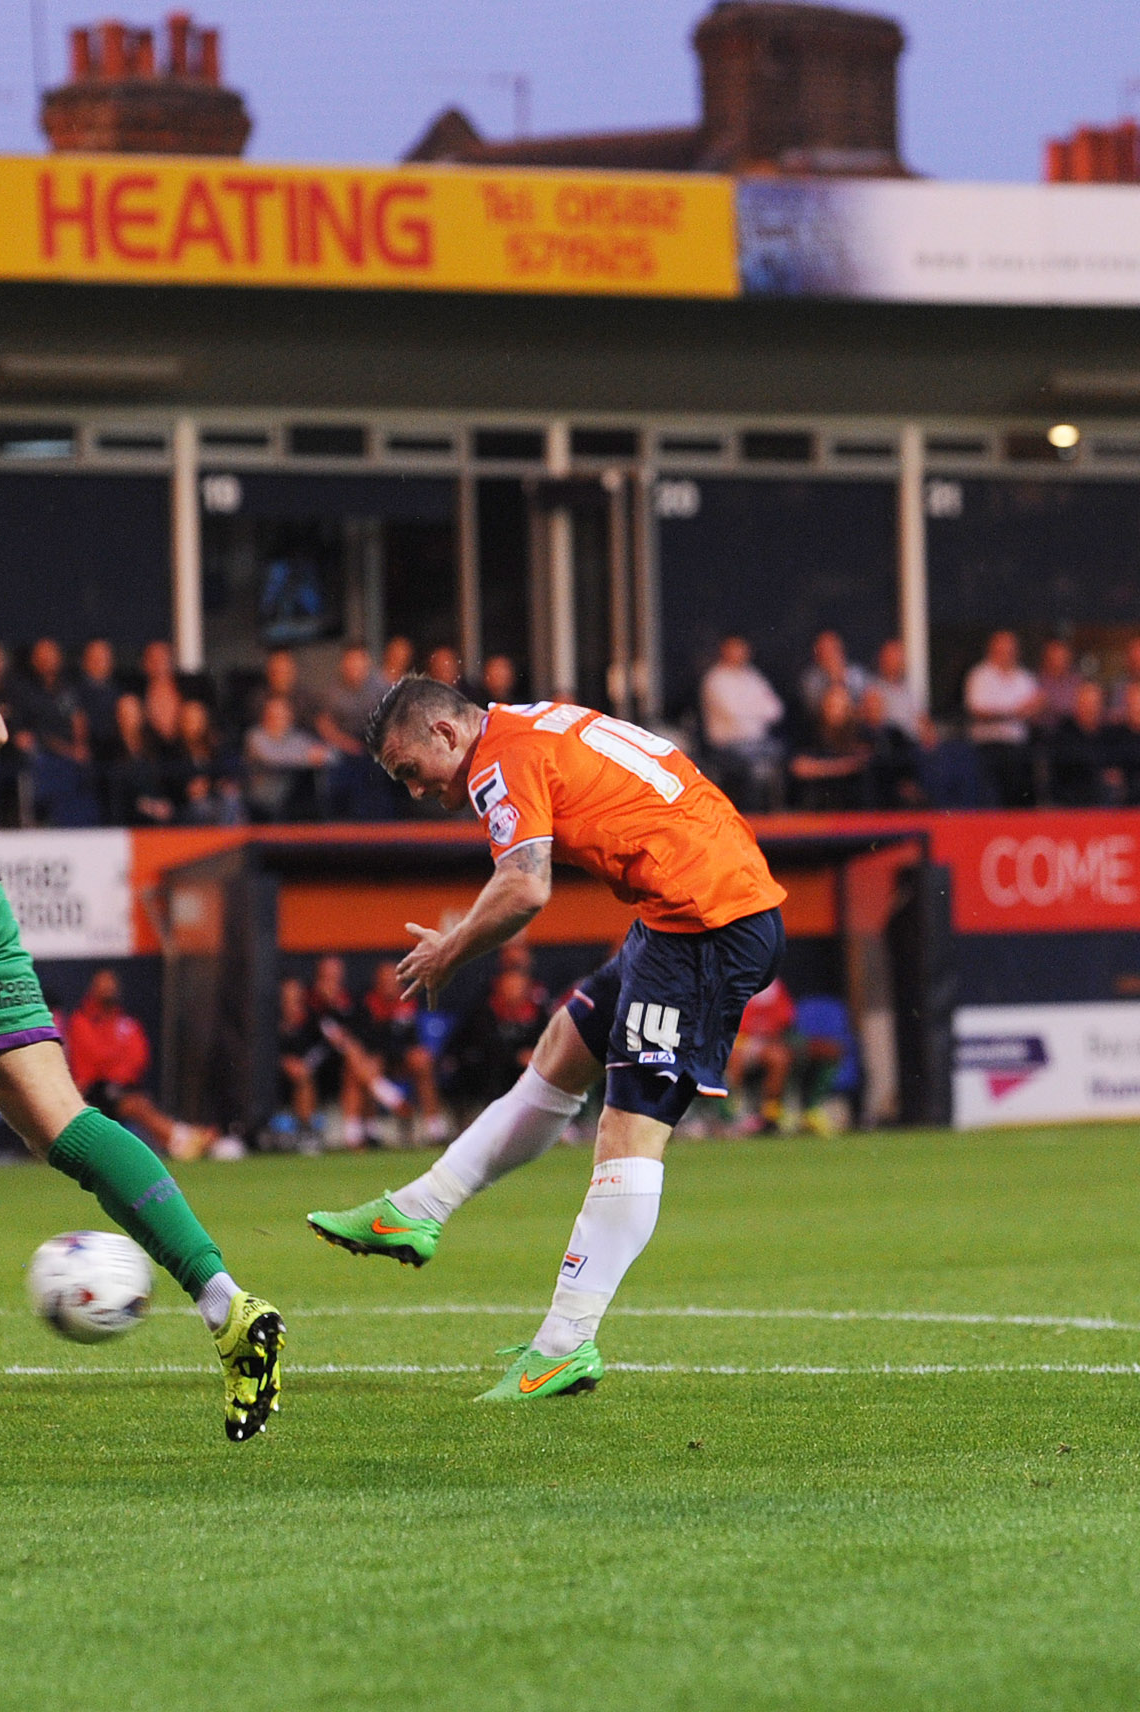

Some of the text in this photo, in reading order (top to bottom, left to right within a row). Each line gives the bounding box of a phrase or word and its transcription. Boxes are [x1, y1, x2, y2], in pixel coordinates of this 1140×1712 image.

[36, 169, 434, 268] HEATING
[979, 836, 1137, 907] COME
[626, 1002, 681, 1053] 14
[642, 1051, 673, 1063] FILA
